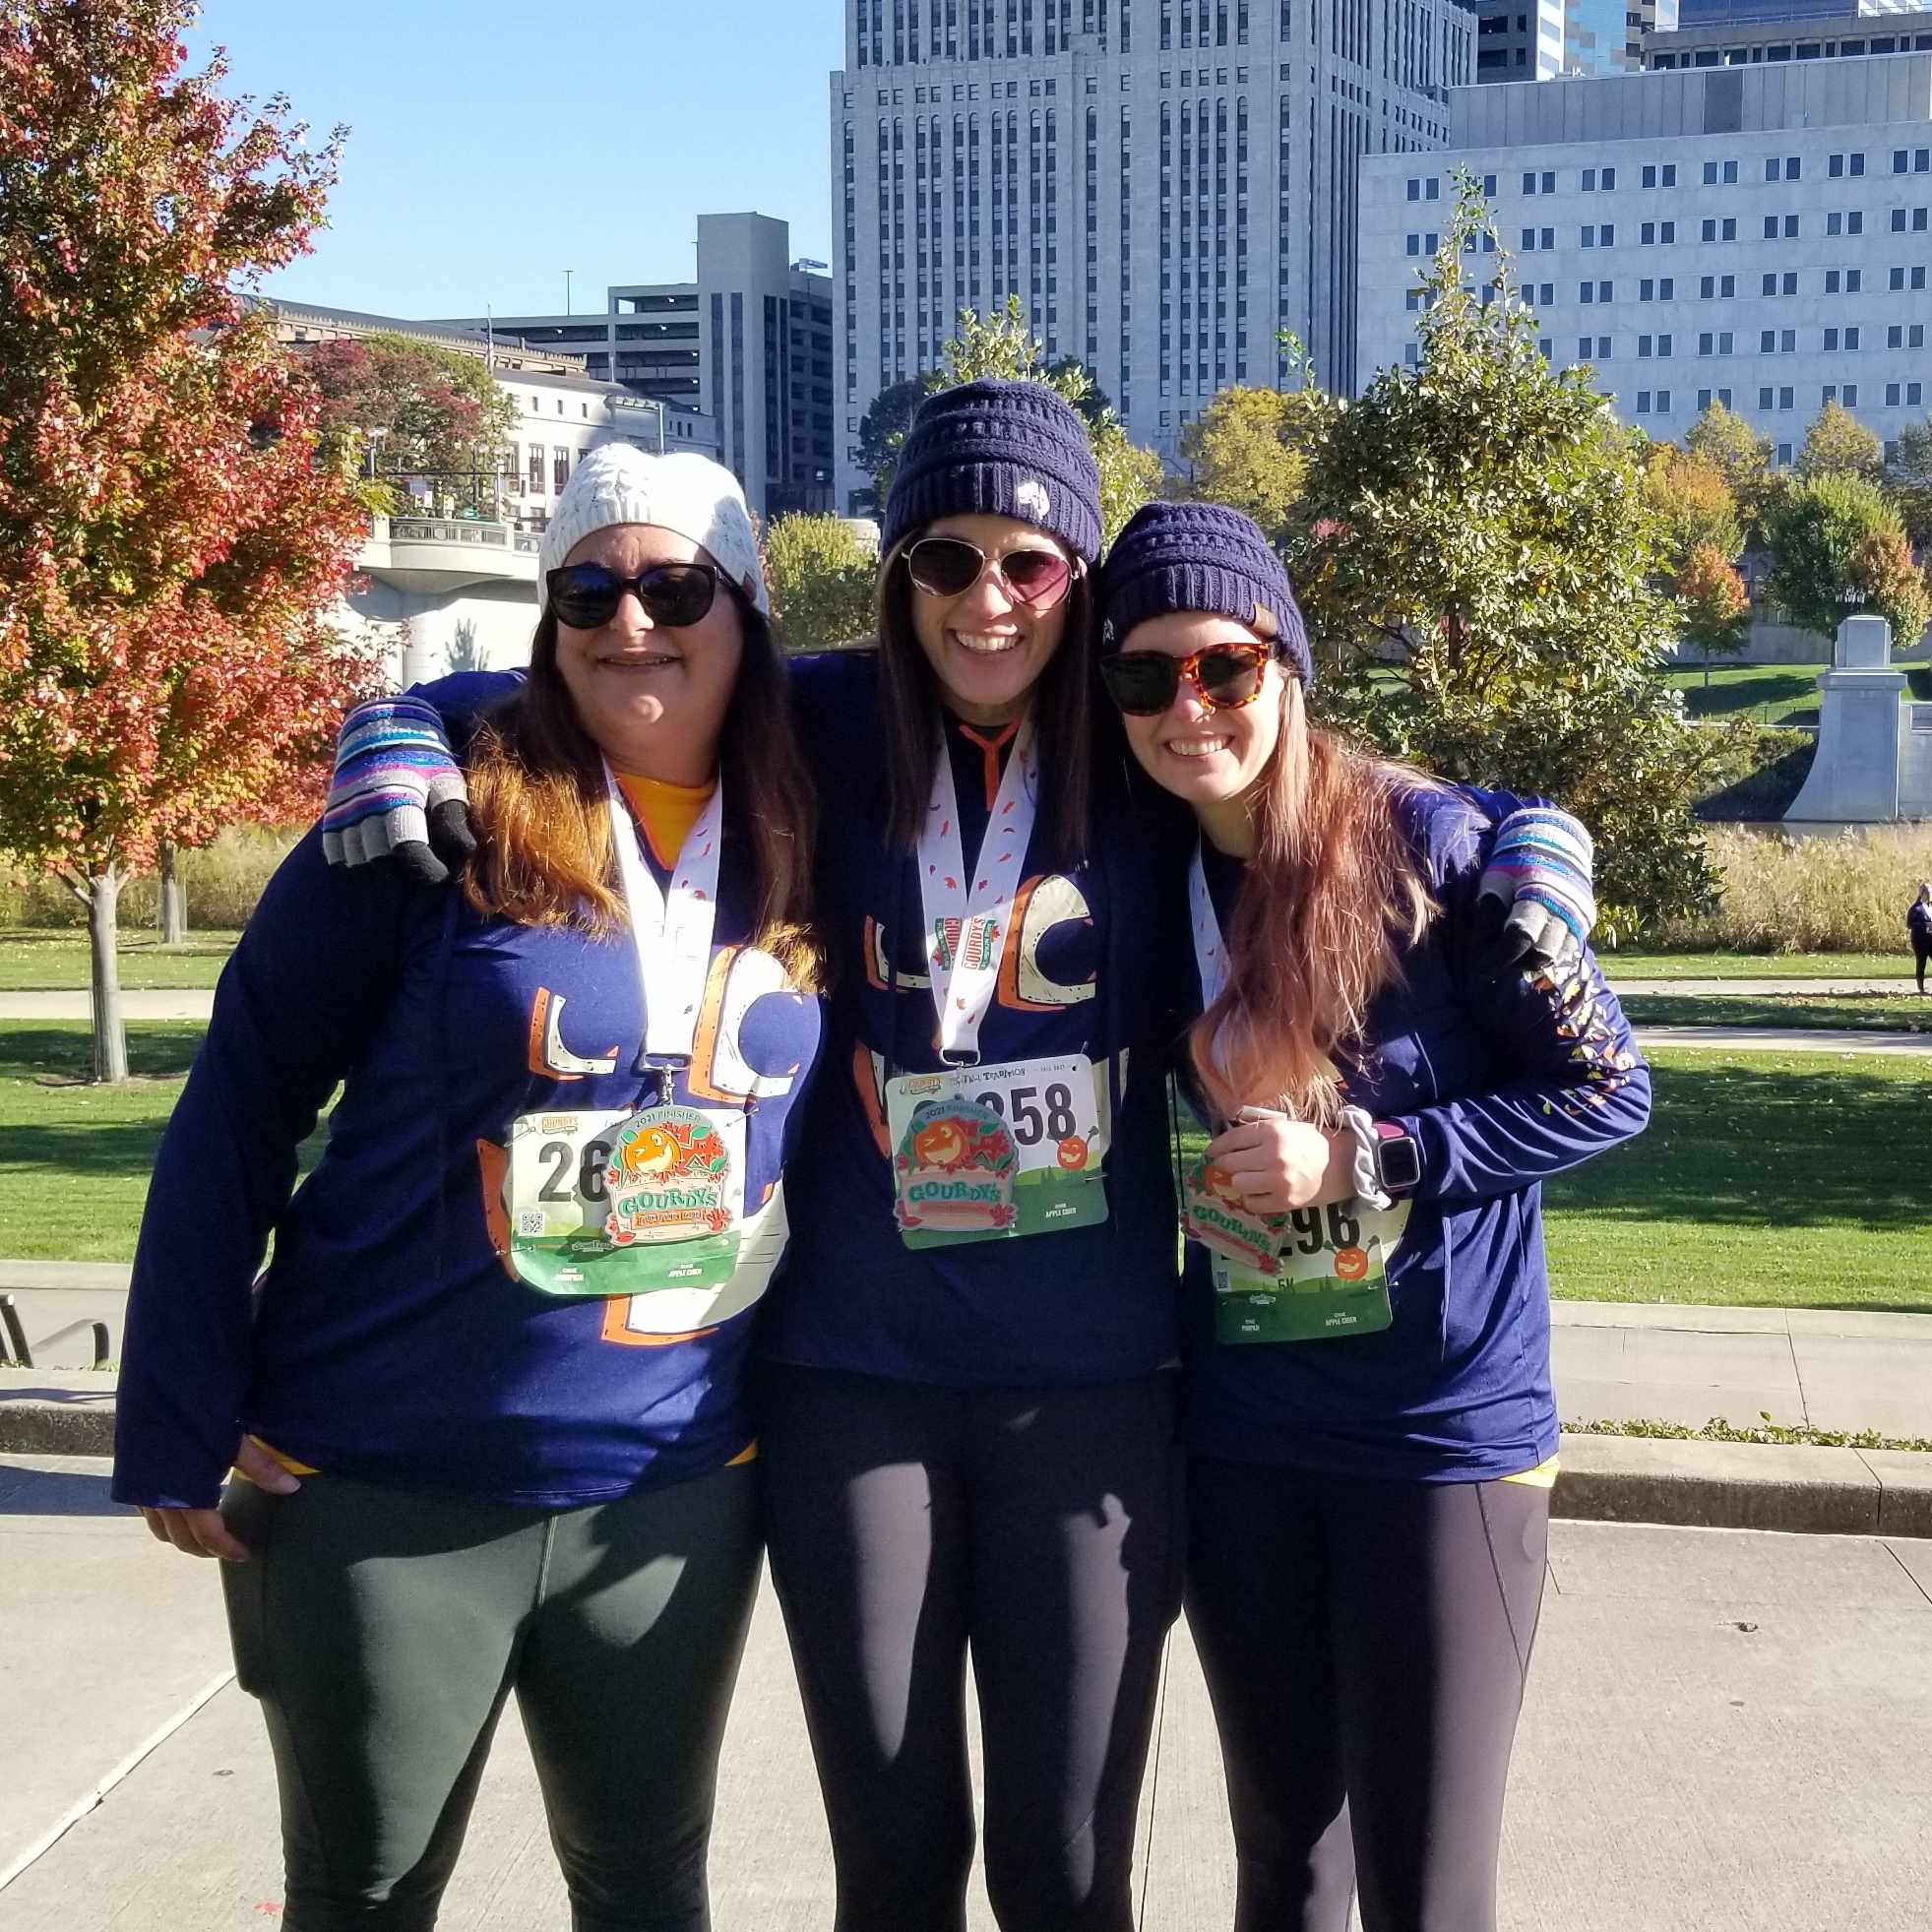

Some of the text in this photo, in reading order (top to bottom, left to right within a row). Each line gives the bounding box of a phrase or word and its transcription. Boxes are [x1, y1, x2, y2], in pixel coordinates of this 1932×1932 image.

[965, 917, 985, 969] GOURDY'S
[913, 1084, 1077, 1146] 58
[618, 1188, 717, 1218] GOURDY'S
[908, 1181, 1001, 1203] GOURDY'S
[1278, 1204, 1360, 1257] 96
